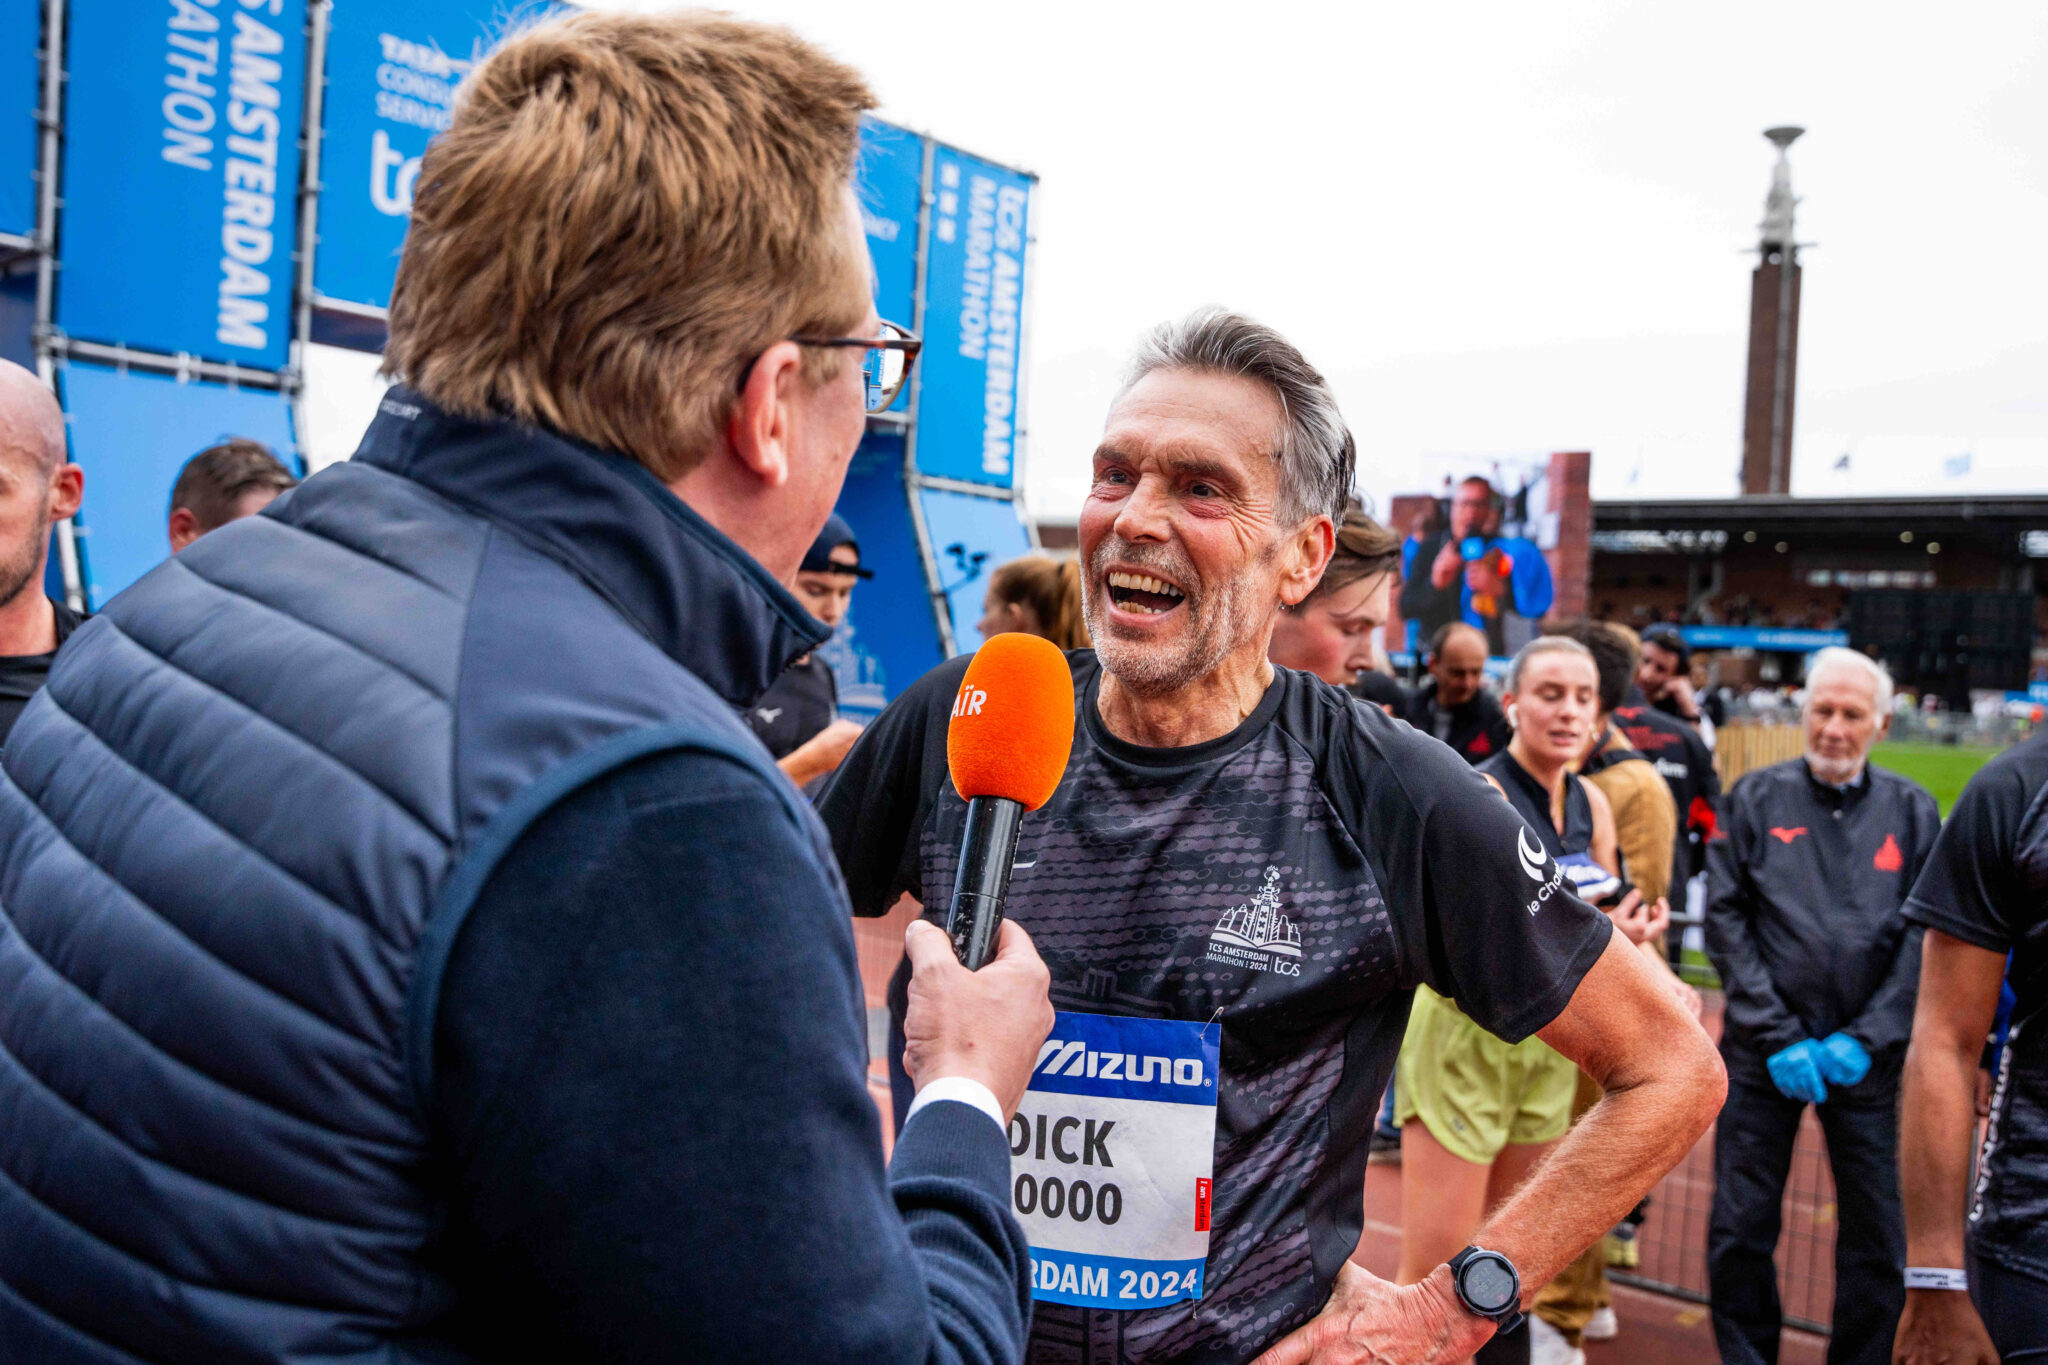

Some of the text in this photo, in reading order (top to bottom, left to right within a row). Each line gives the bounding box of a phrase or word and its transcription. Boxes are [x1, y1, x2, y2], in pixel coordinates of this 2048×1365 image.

[161, 0, 220, 171] ATHON
[216, 10, 284, 350] AMSTERDAM
[958, 174, 997, 360] MARATHON
[981, 250, 1020, 475] AMSTERDAM
[1205, 952, 1268, 972] MARATHON 2024
[1208, 942, 1270, 963] TCS AMSTERDAM
[1274, 956, 1301, 977] tcs
[1006, 1111, 1117, 1168] DICK
[1014, 1172, 1122, 1226] 0000
[1119, 1268, 1198, 1299] 2024
